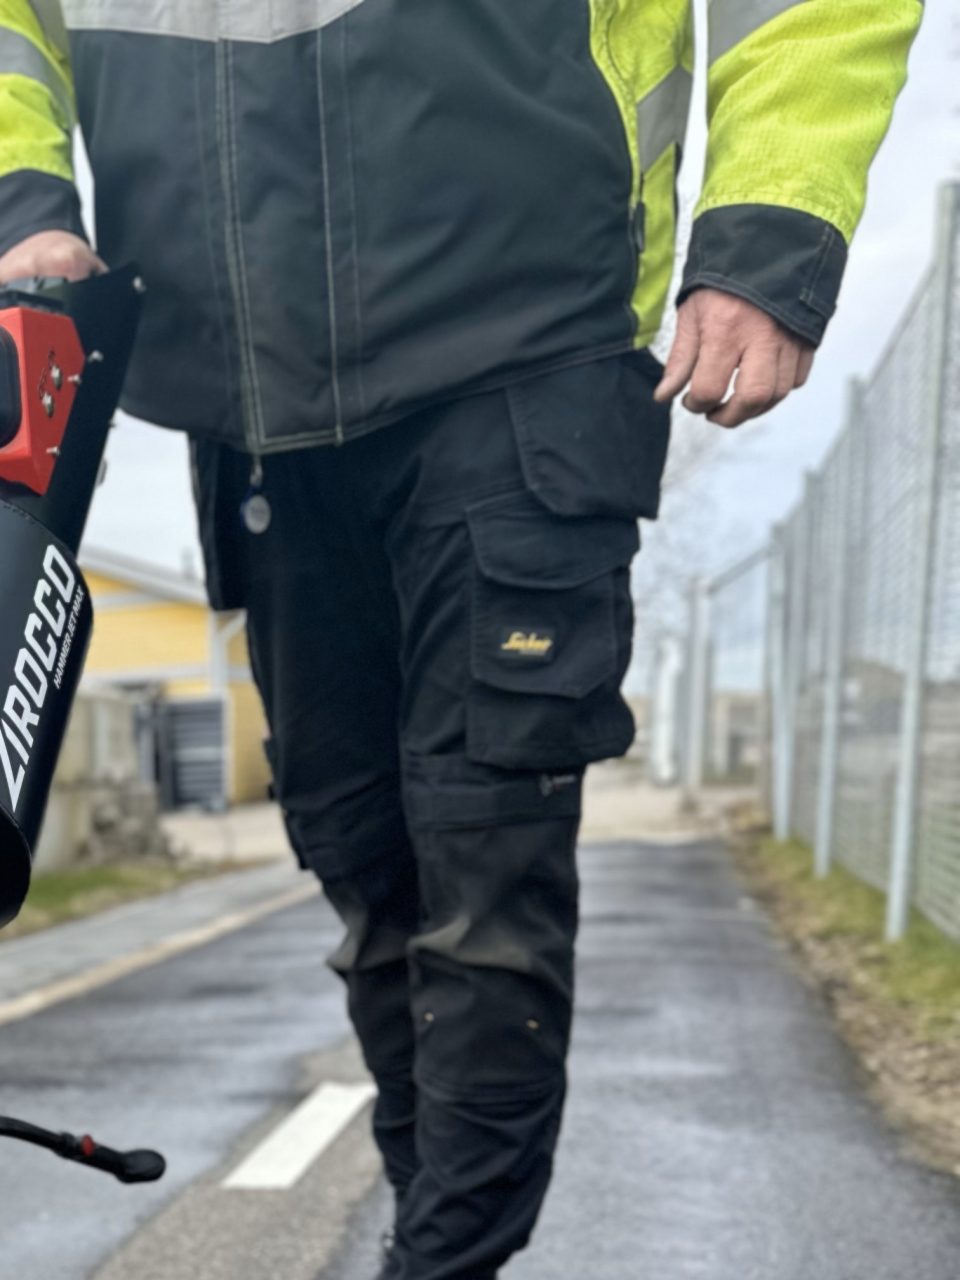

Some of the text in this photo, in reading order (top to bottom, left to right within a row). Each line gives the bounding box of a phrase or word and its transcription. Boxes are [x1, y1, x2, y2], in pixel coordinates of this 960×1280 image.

[53, 585, 84, 689] HAMMER JET MAX
